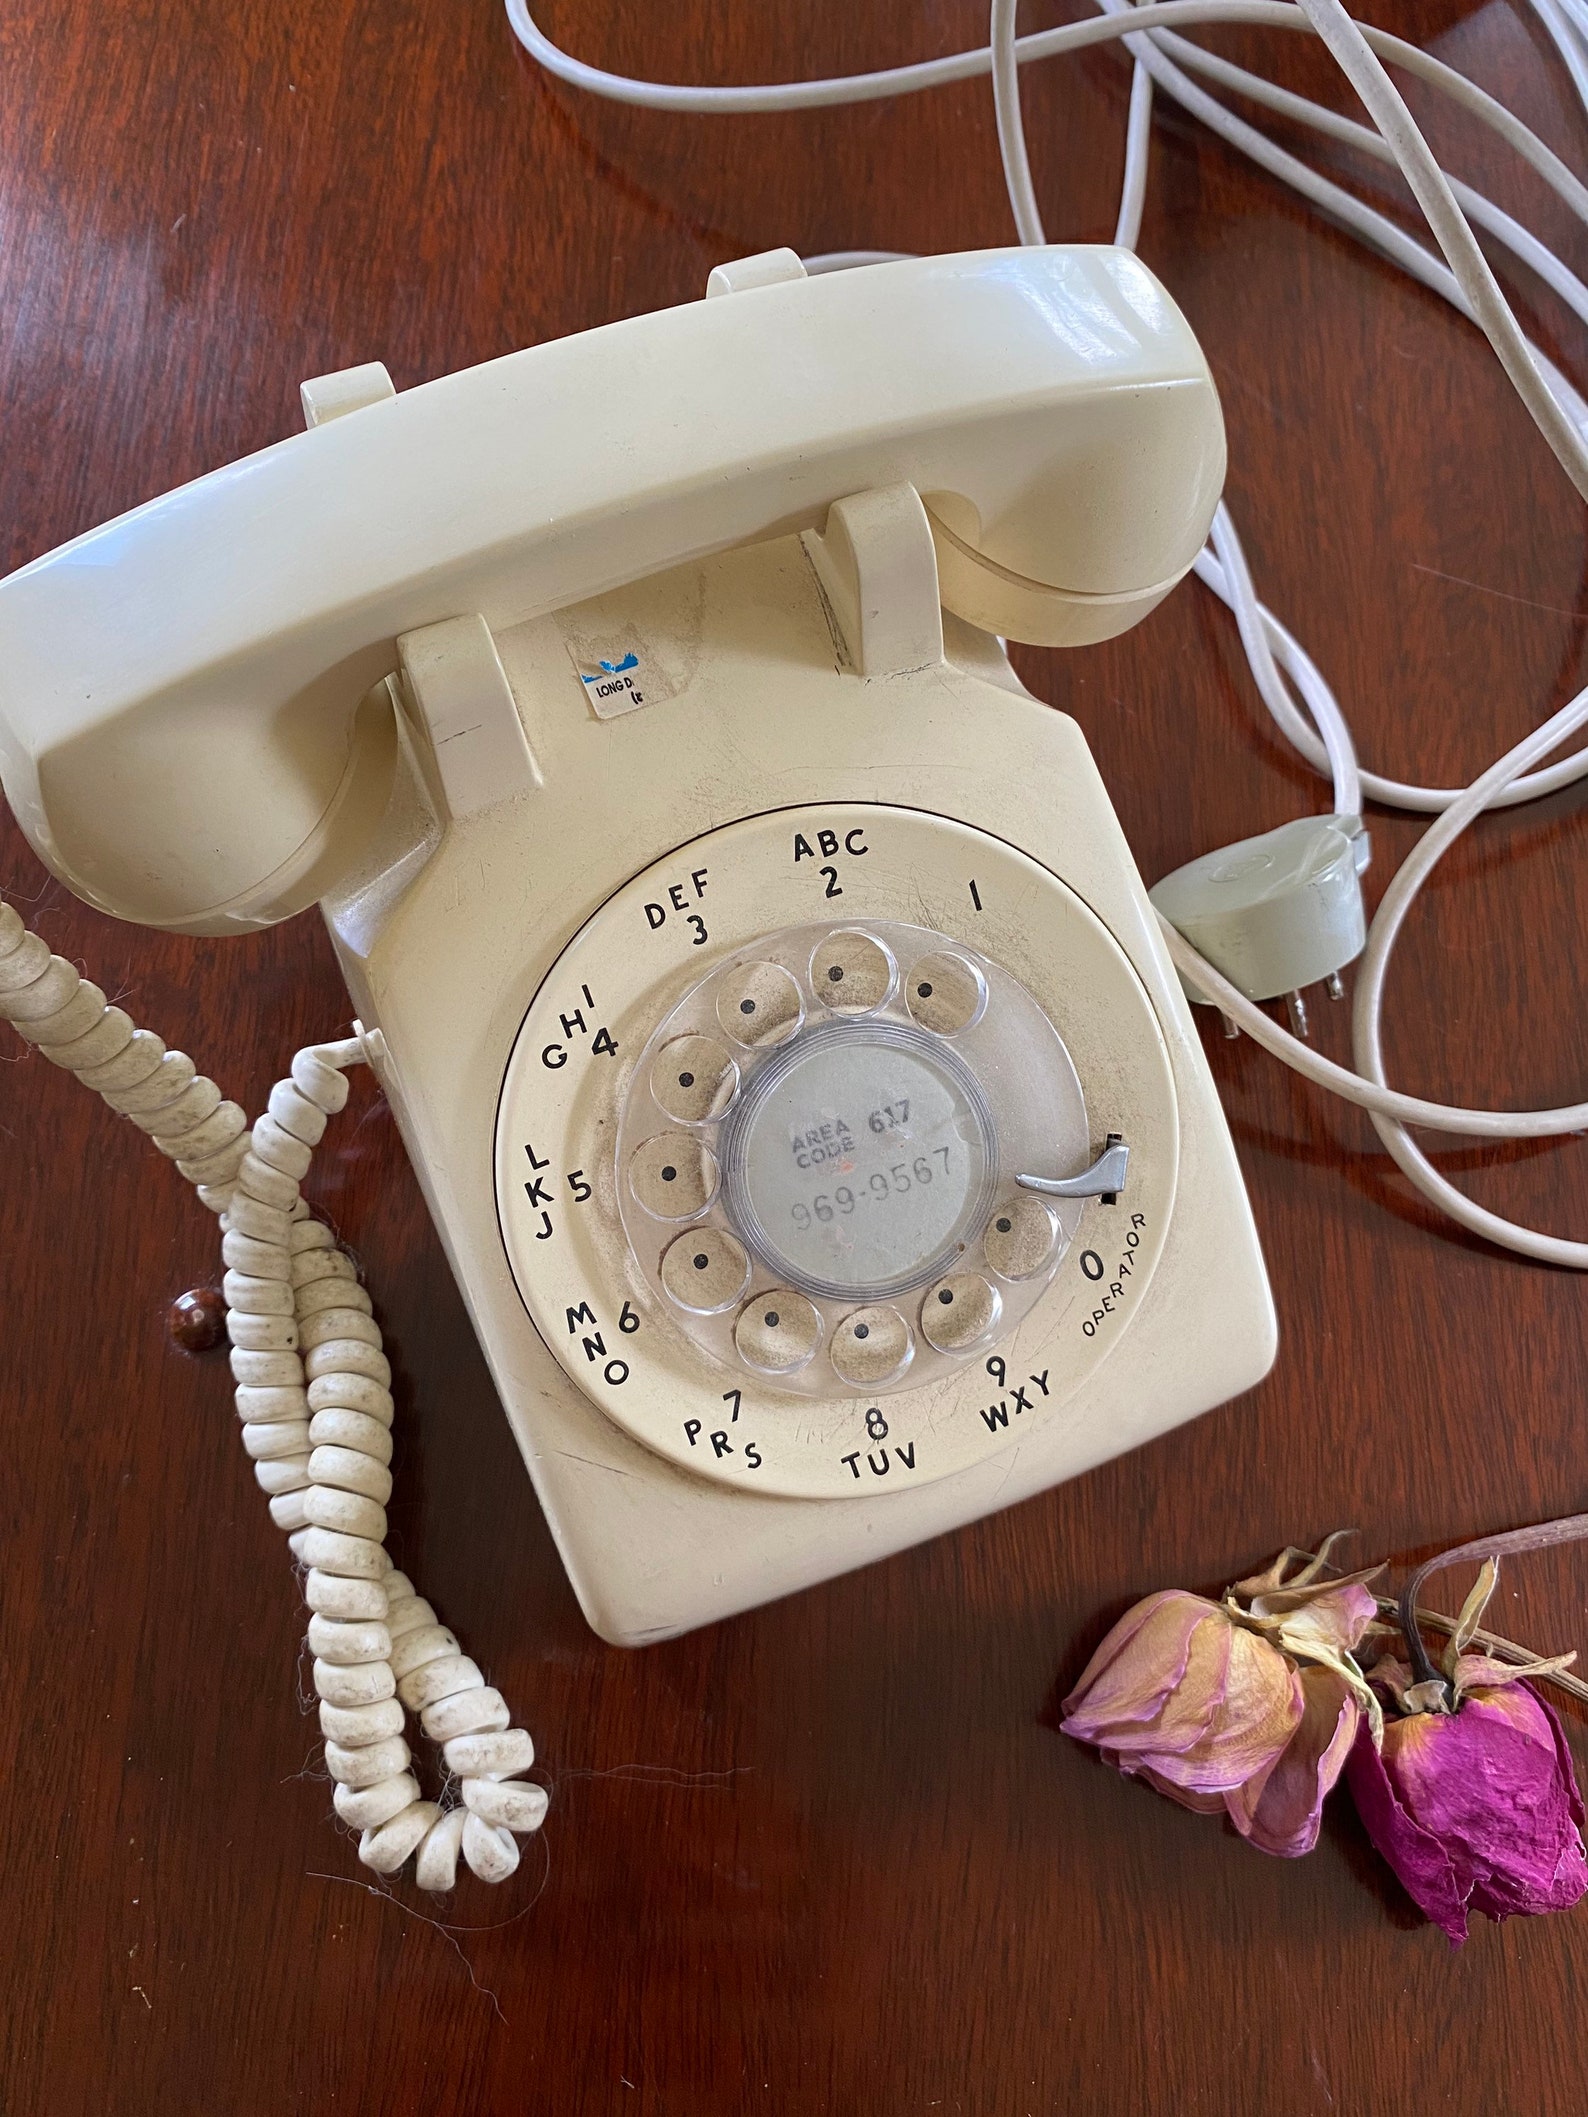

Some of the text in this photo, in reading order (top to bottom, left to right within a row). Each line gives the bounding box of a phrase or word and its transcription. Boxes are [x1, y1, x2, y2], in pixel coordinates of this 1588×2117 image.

[595, 680, 624, 698] LONG
[794, 828, 869, 863] ABC
[643, 868, 708, 930] DEF
[819, 866, 843, 899] 2
[968, 879, 983, 912] 1
[690, 914, 708, 946] 3
[591, 1027, 619, 1057] 4
[868, 1099, 910, 1134] 617
[792, 1119, 850, 1153] AREA
[796, 1136, 855, 1169] CODE
[566, 1169, 592, 1203] 5
[791, 1145, 950, 1231] 969-9567
[1079, 1249, 1104, 1281] 0
[1082, 1213, 1146, 1337] OPERATOR
[618, 1300, 640, 1334] 6
[986, 1355, 1006, 1387] 9
[722, 1389, 742, 1423] 7
[979, 1369, 1050, 1433] WXY
[865, 1407, 889, 1441] 8
[683, 1419, 762, 1469] PRS
[840, 1441, 916, 1479] TUV
